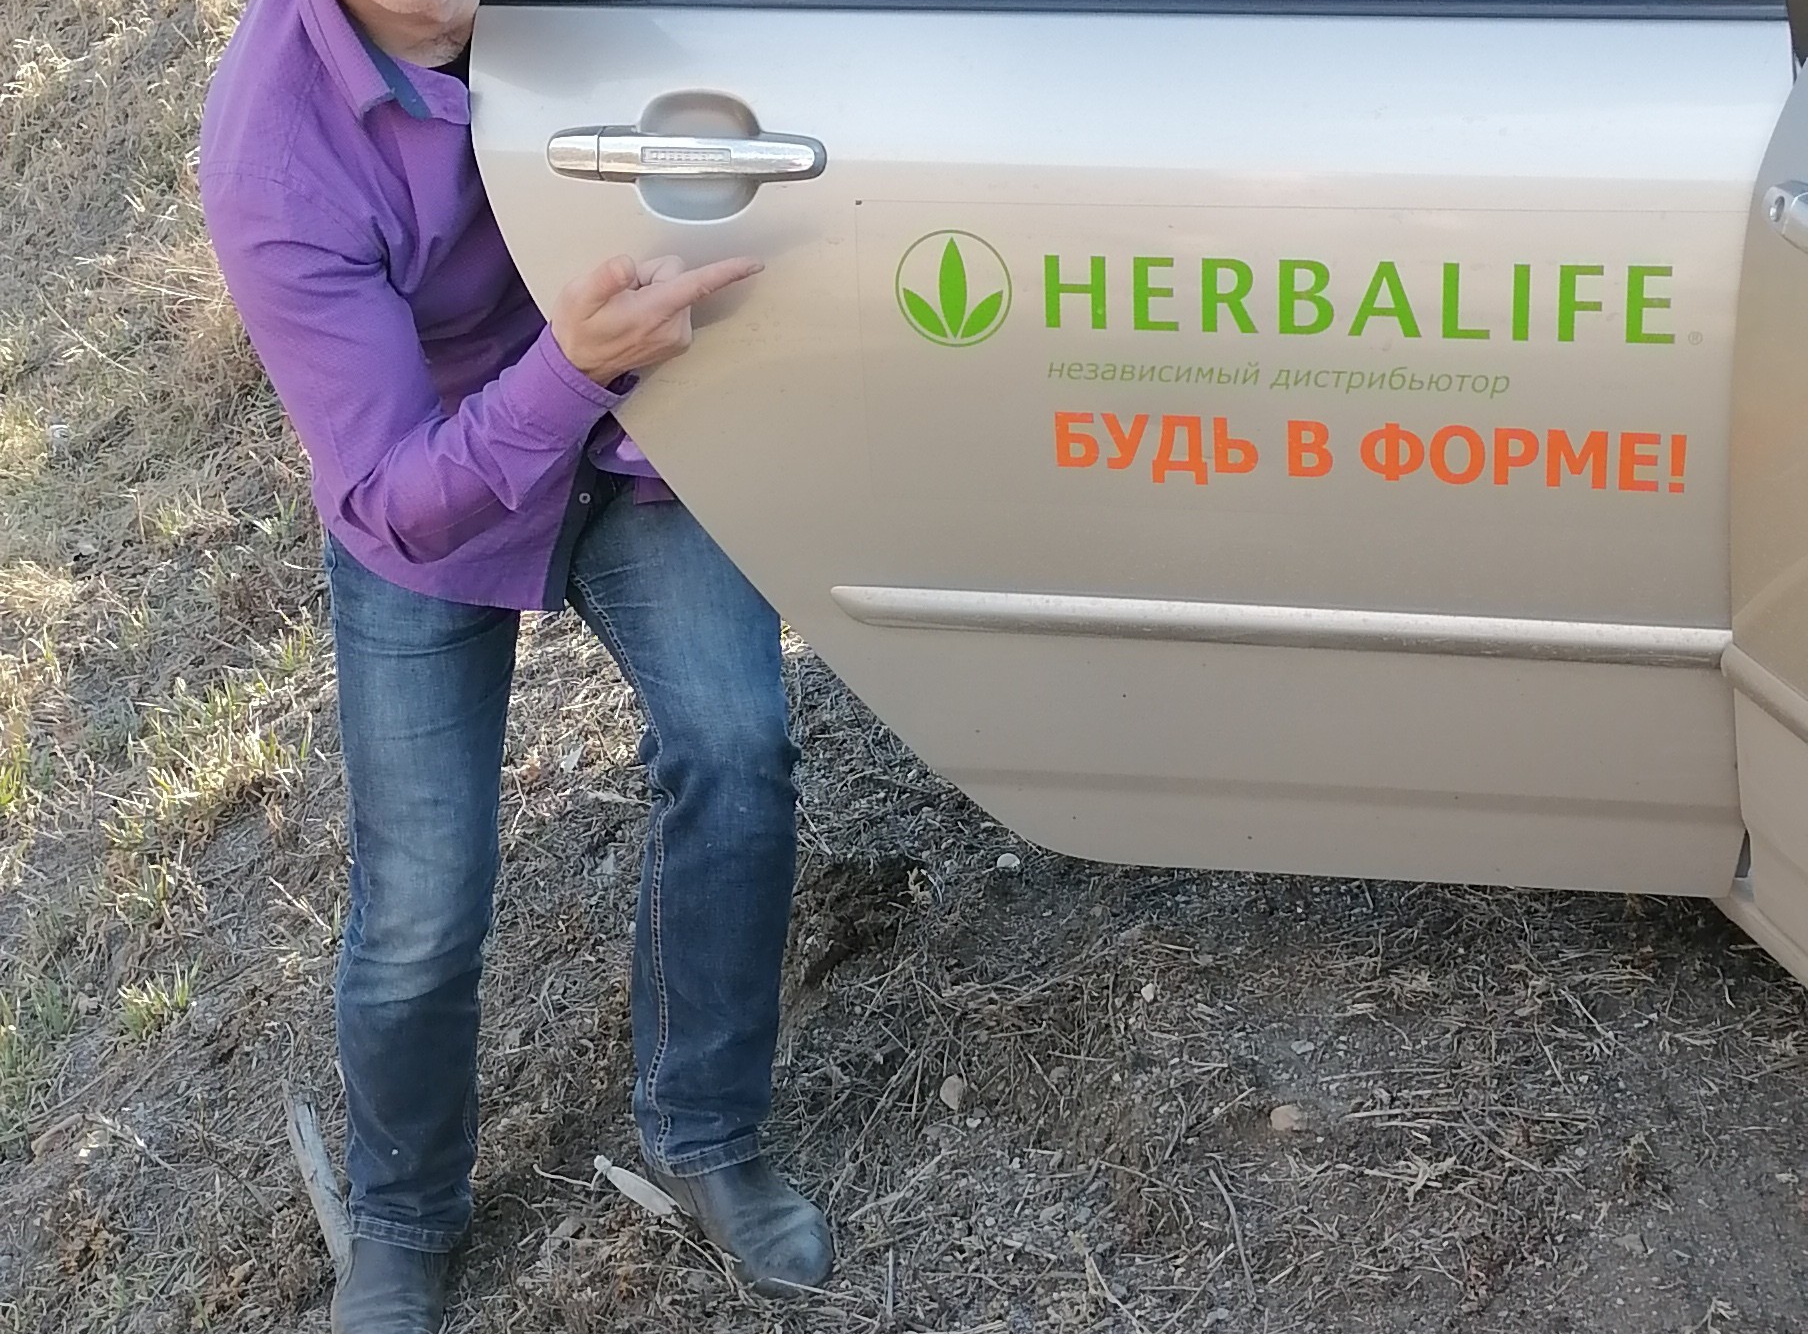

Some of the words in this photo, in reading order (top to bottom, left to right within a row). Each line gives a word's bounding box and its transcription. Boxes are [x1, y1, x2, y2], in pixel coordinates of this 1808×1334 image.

[1044, 254, 1675, 344] HERBALIFE
[1047, 360, 1261, 387] независимый
[1270, 363, 1511, 398] дистрибьютор
[1054, 411, 1259, 486] БУДЬ
[1287, 419, 1334, 478] В
[1359, 422, 1688, 494] ФОРМЕ!
